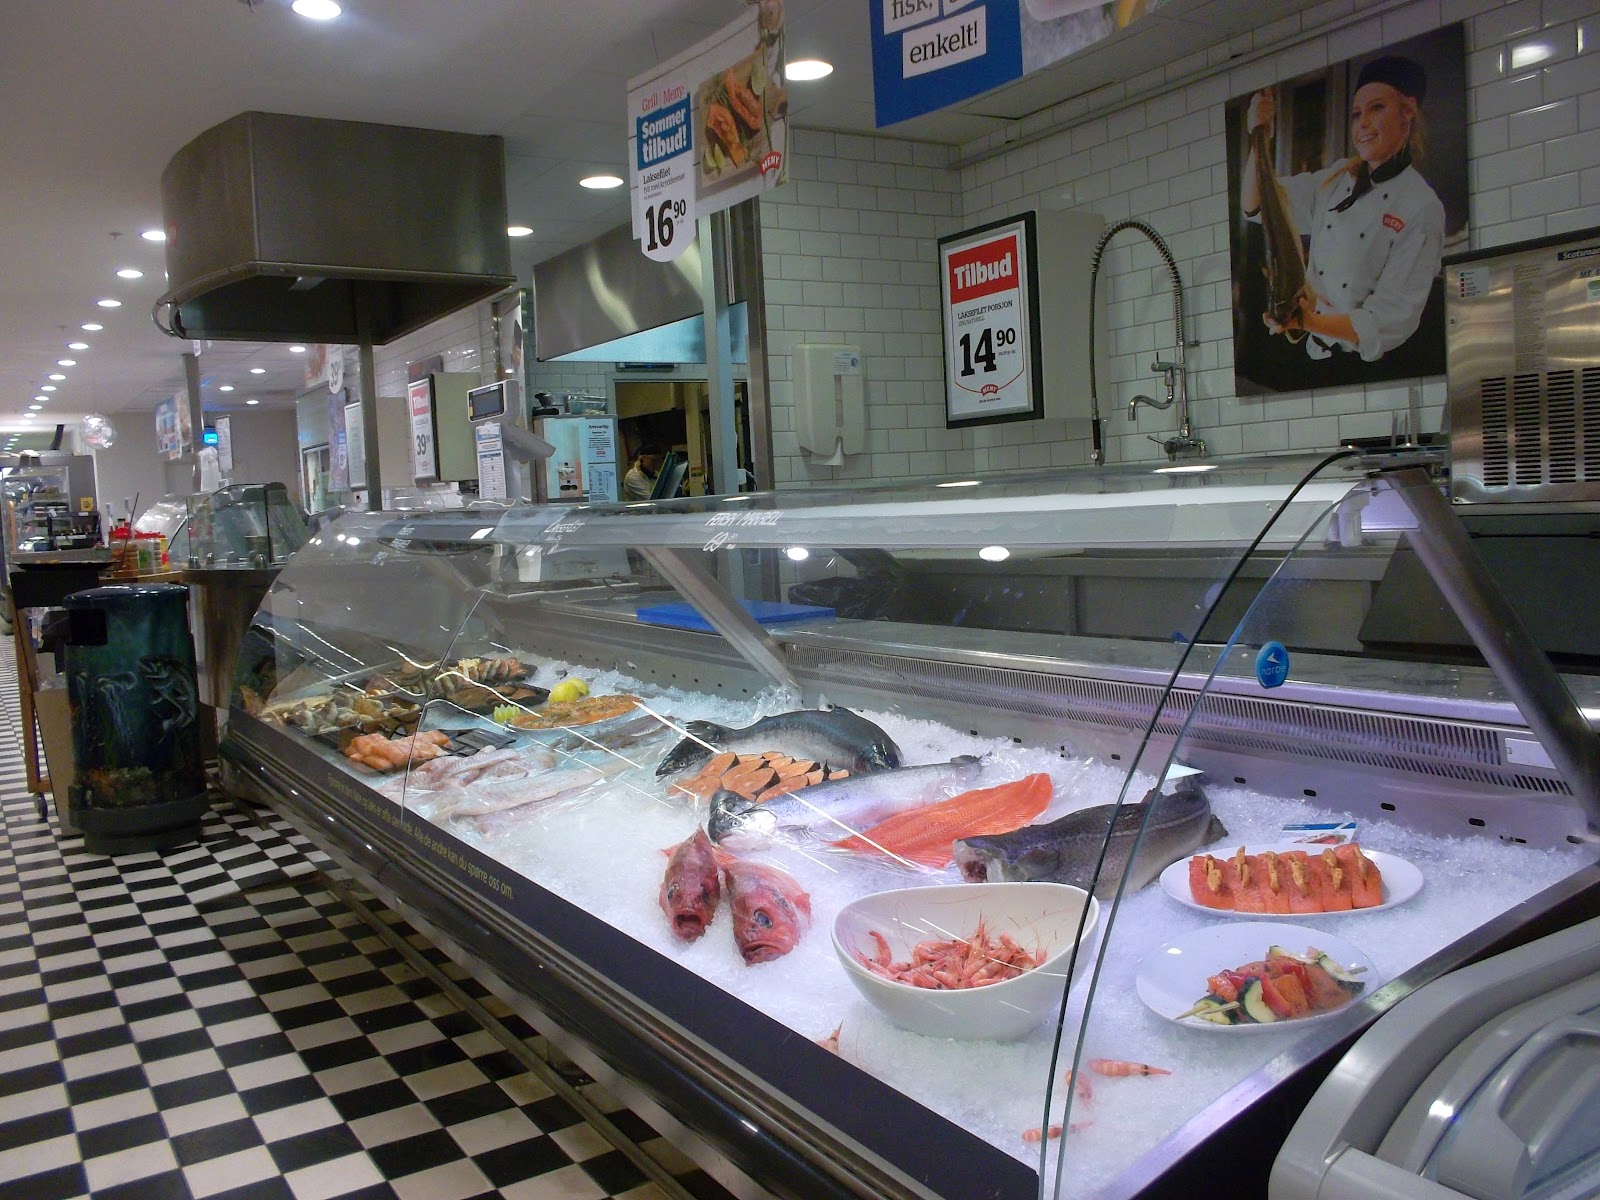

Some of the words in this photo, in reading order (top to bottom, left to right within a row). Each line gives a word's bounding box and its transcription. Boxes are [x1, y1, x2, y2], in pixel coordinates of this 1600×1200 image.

[909, 21, 978, 65] enkelt!
[641, 93, 659, 112] Grill
[641, 107, 686, 139] Sommer
[642, 124, 687, 163] tilbud!
[761, 155, 781, 170] MENY
[643, 166, 671, 185] Laksefilet
[645, 199, 674, 252] 16
[673, 198, 686, 219] 90
[953, 252, 1013, 290] Tilbud
[957, 305, 987, 320] LAKSEFILET
[987, 299, 1013, 313] PORSJON
[959, 327, 997, 377] 14
[996, 327, 1016, 347] 90
[982, 385, 997, 395] MENY
[416, 433, 427, 455] 39
[704, 512, 742, 527] FERSK
[735, 511, 784, 527] MAKRELL
[1261, 664, 1287, 676] norpe
[448, 848, 458, 866] kan
[458, 854, 467, 871] du
[488, 875, 499, 892] oss
[500, 883, 514, 900] om.
